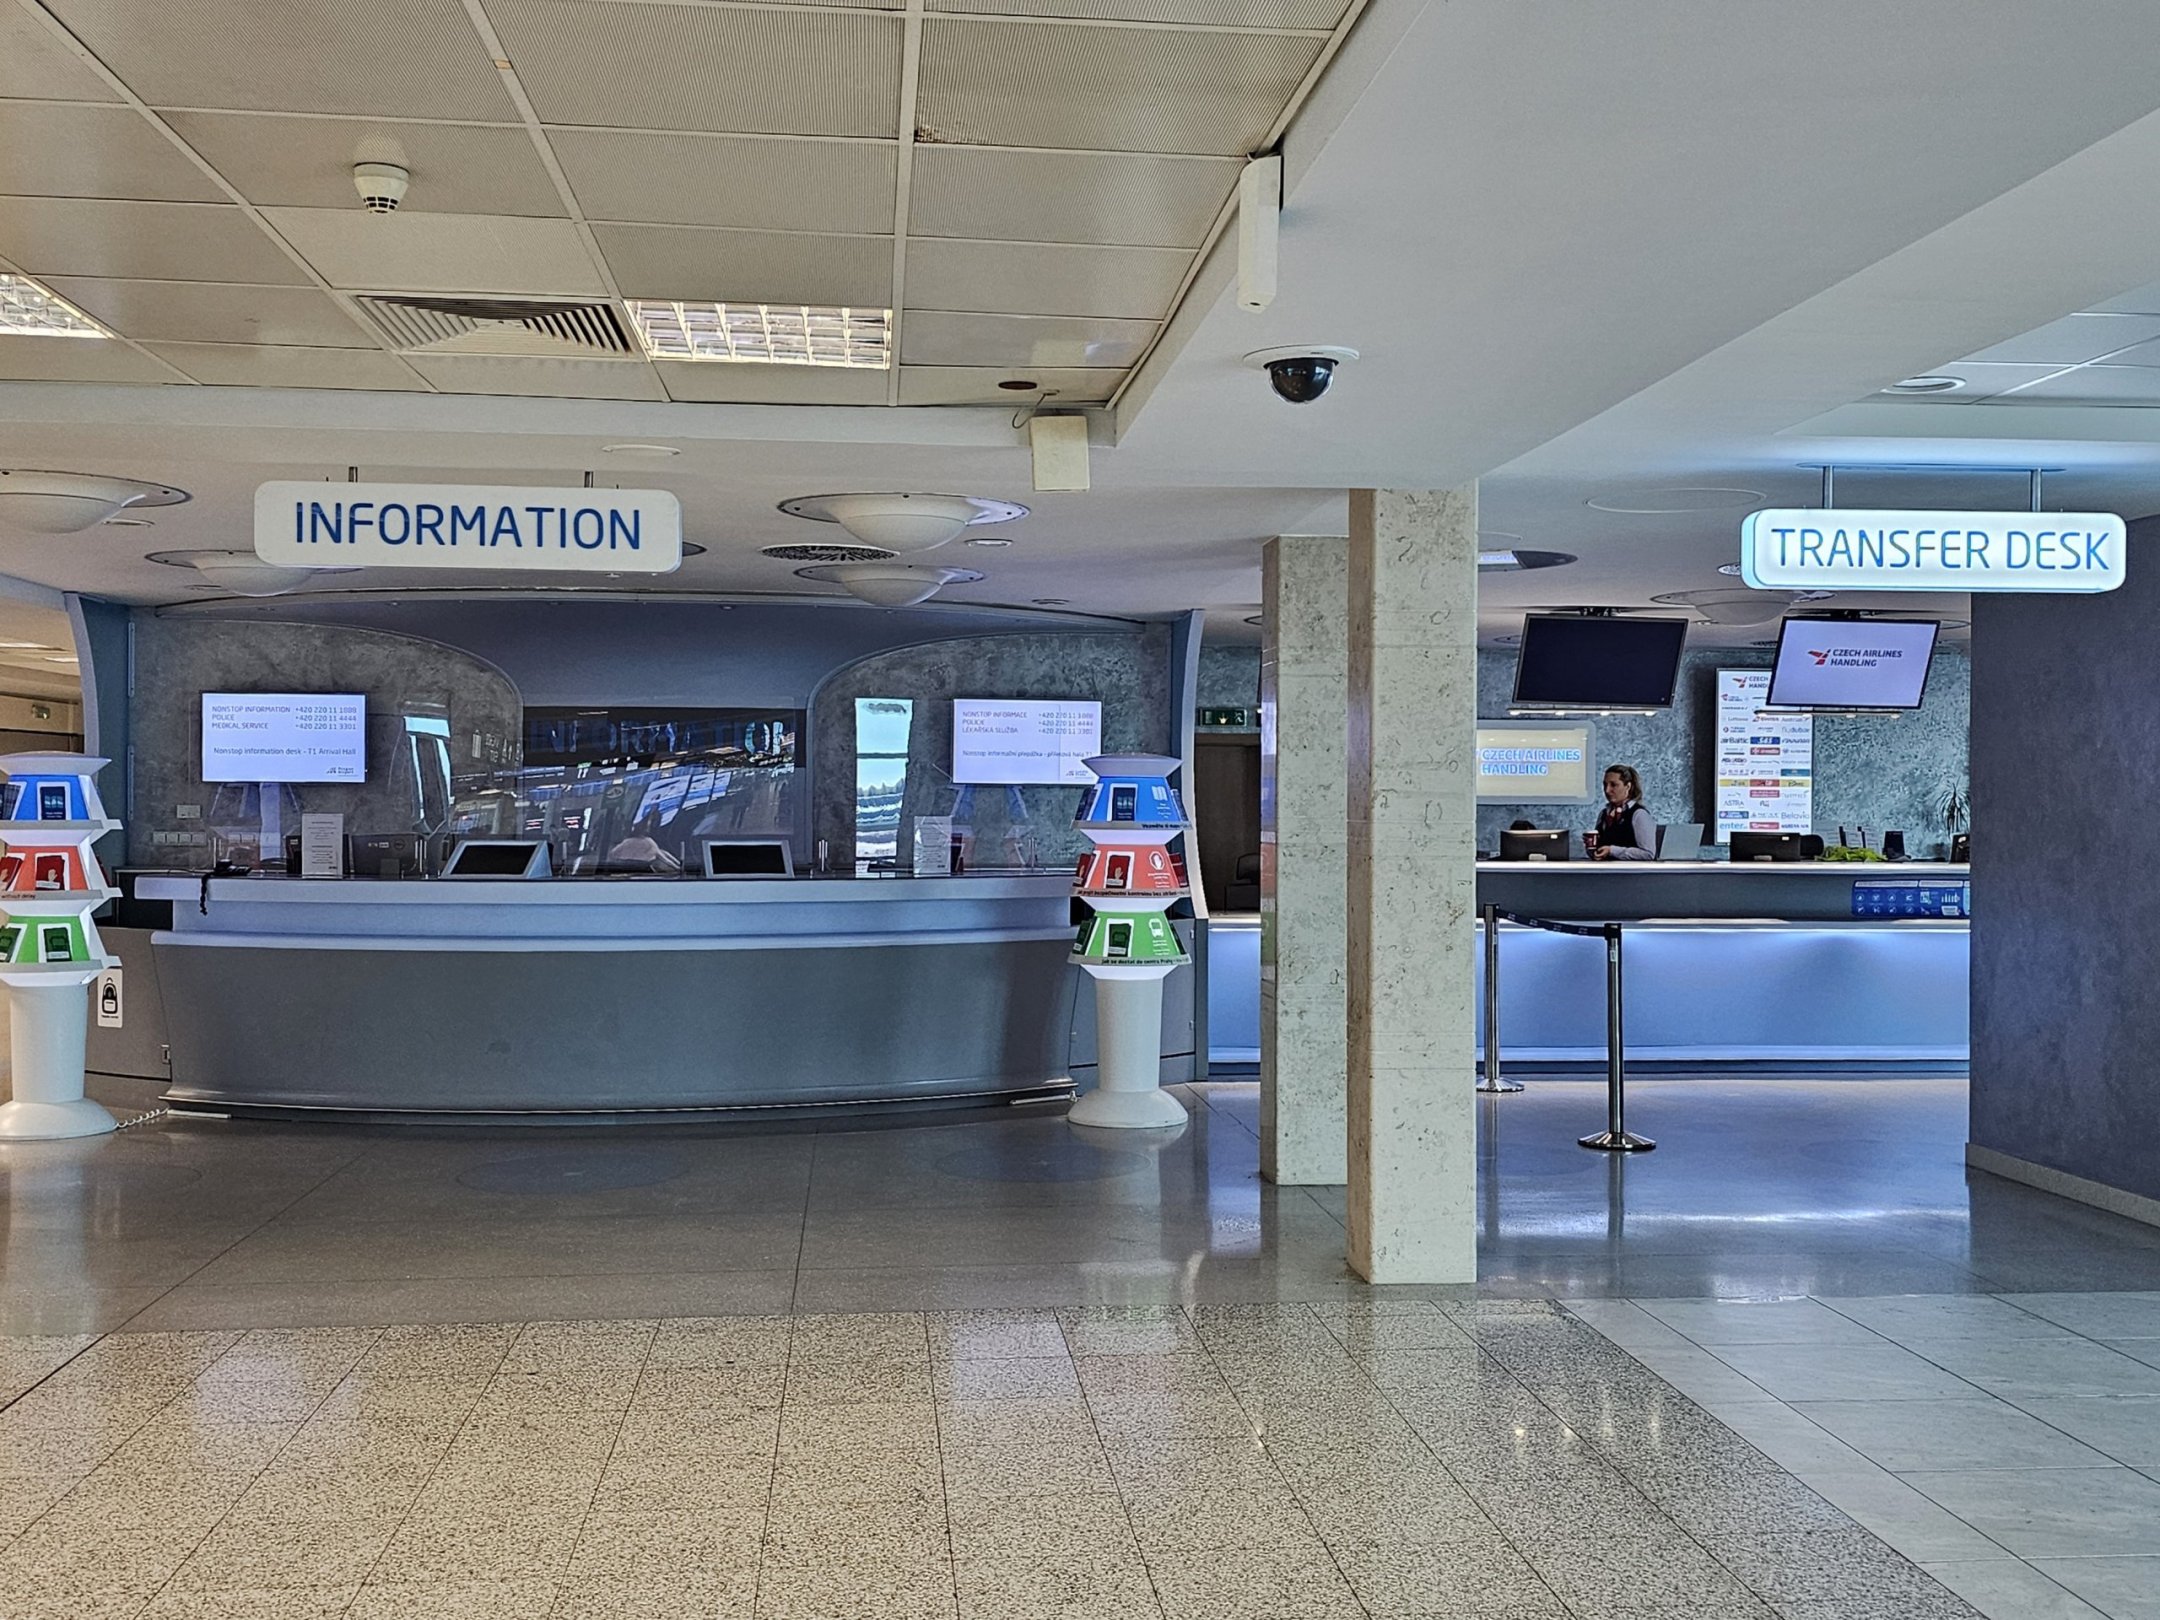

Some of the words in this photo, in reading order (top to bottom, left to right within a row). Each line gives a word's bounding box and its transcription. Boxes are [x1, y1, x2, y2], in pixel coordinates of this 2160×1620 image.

[296, 502, 640, 550] INFORMATION
[1771, 528, 1990, 569] TRANSFER
[2007, 531, 2110, 570] DESK
[1833, 649, 1860, 657] CZECH
[1830, 659, 1877, 667] HANDLING
[1482, 749, 1521, 760] CZECH
[1525, 749, 1580, 760] AIRLINES
[1482, 764, 1547, 774] HANDLING
